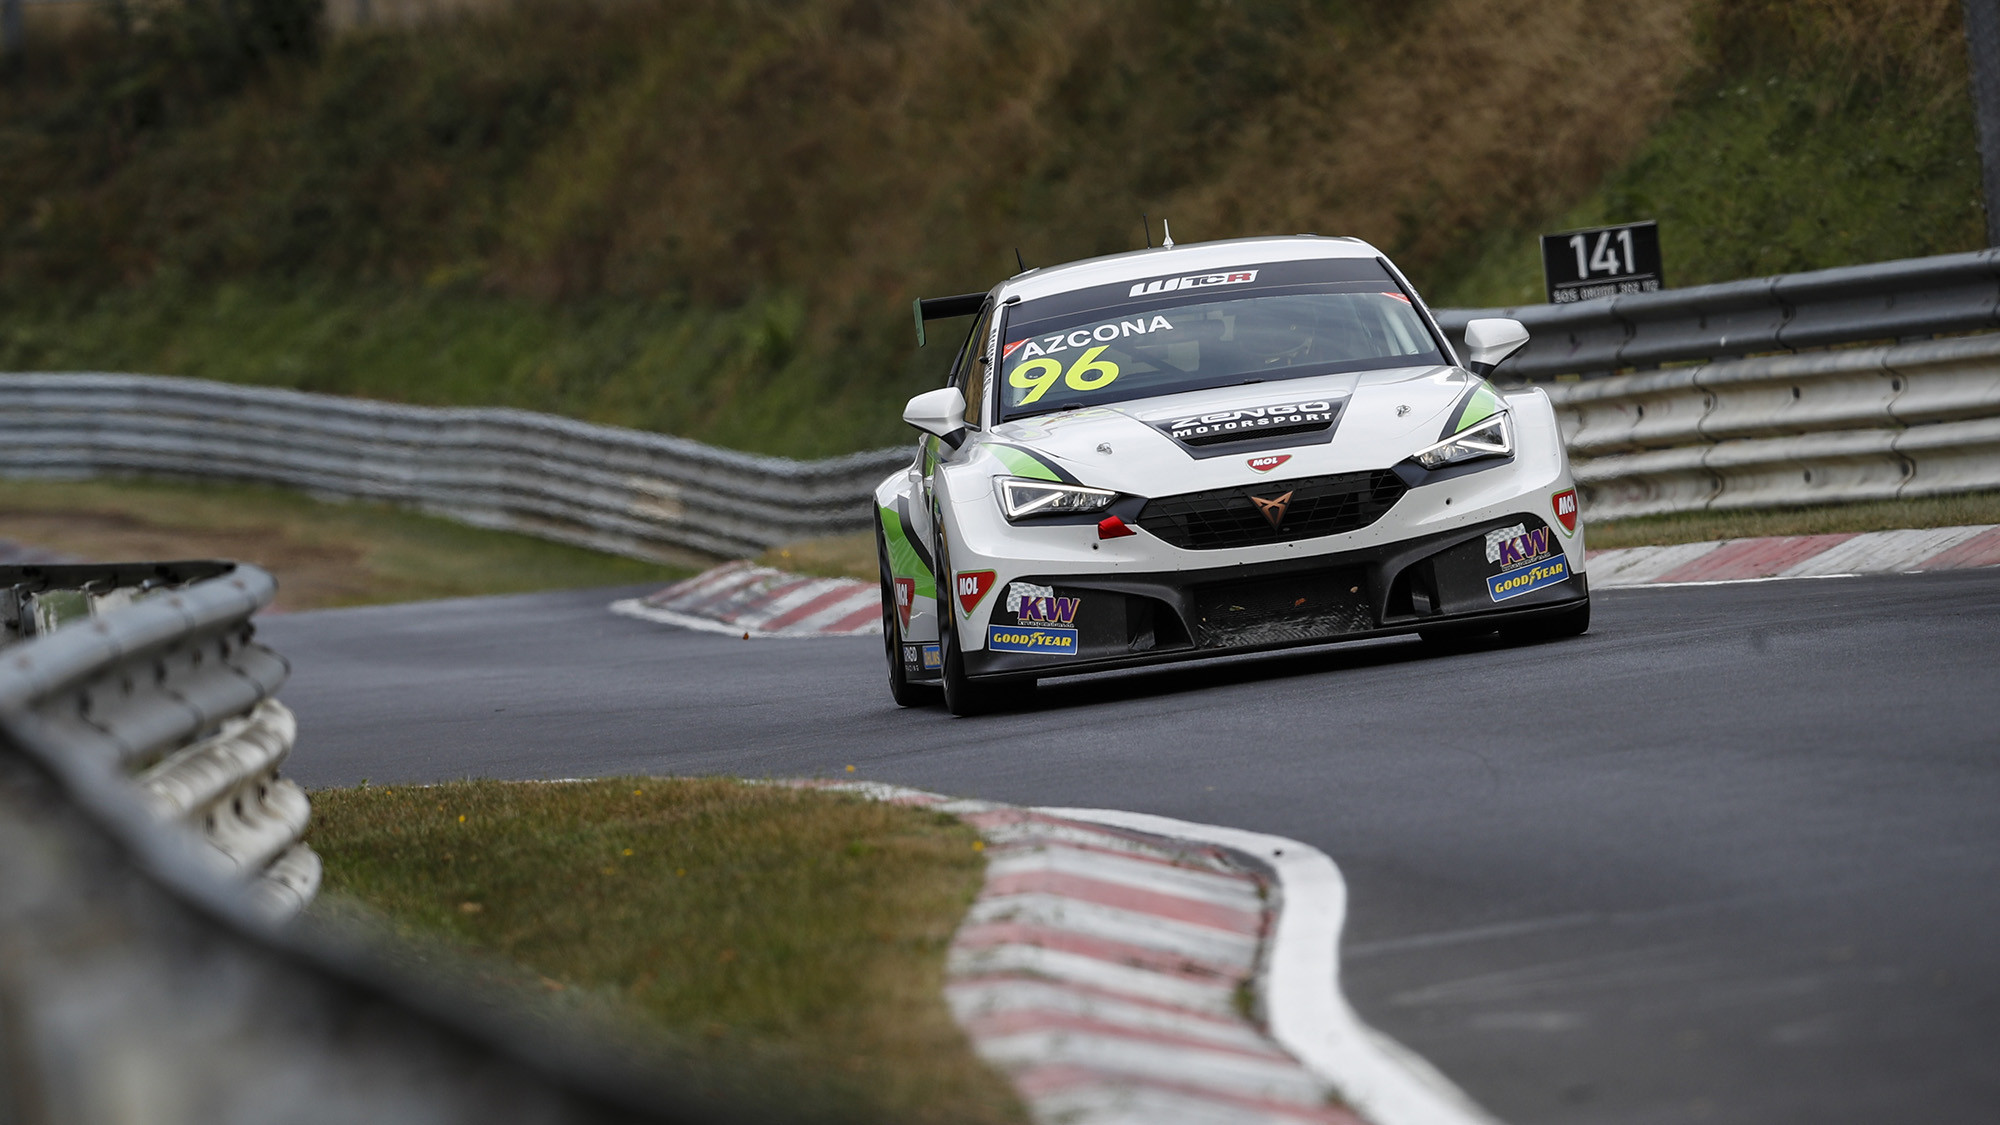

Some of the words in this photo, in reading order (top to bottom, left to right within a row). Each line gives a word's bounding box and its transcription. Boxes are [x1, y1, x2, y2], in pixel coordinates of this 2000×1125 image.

[1570, 229, 1635, 279] 141
[1129, 269, 1259, 298] WTCR
[1021, 315, 1173, 361] AZCONA
[1008, 344, 1120, 406] 96
[1170, 400, 1331, 430] ZENGO
[1172, 412, 1333, 439] MOTORSPORT
[1252, 456, 1278, 467] MOL
[1558, 494, 1576, 516] MOL
[1498, 526, 1549, 566] KW
[896, 582, 908, 607] MOL
[959, 576, 979, 596] MOL
[1018, 595, 1081, 622] KW
